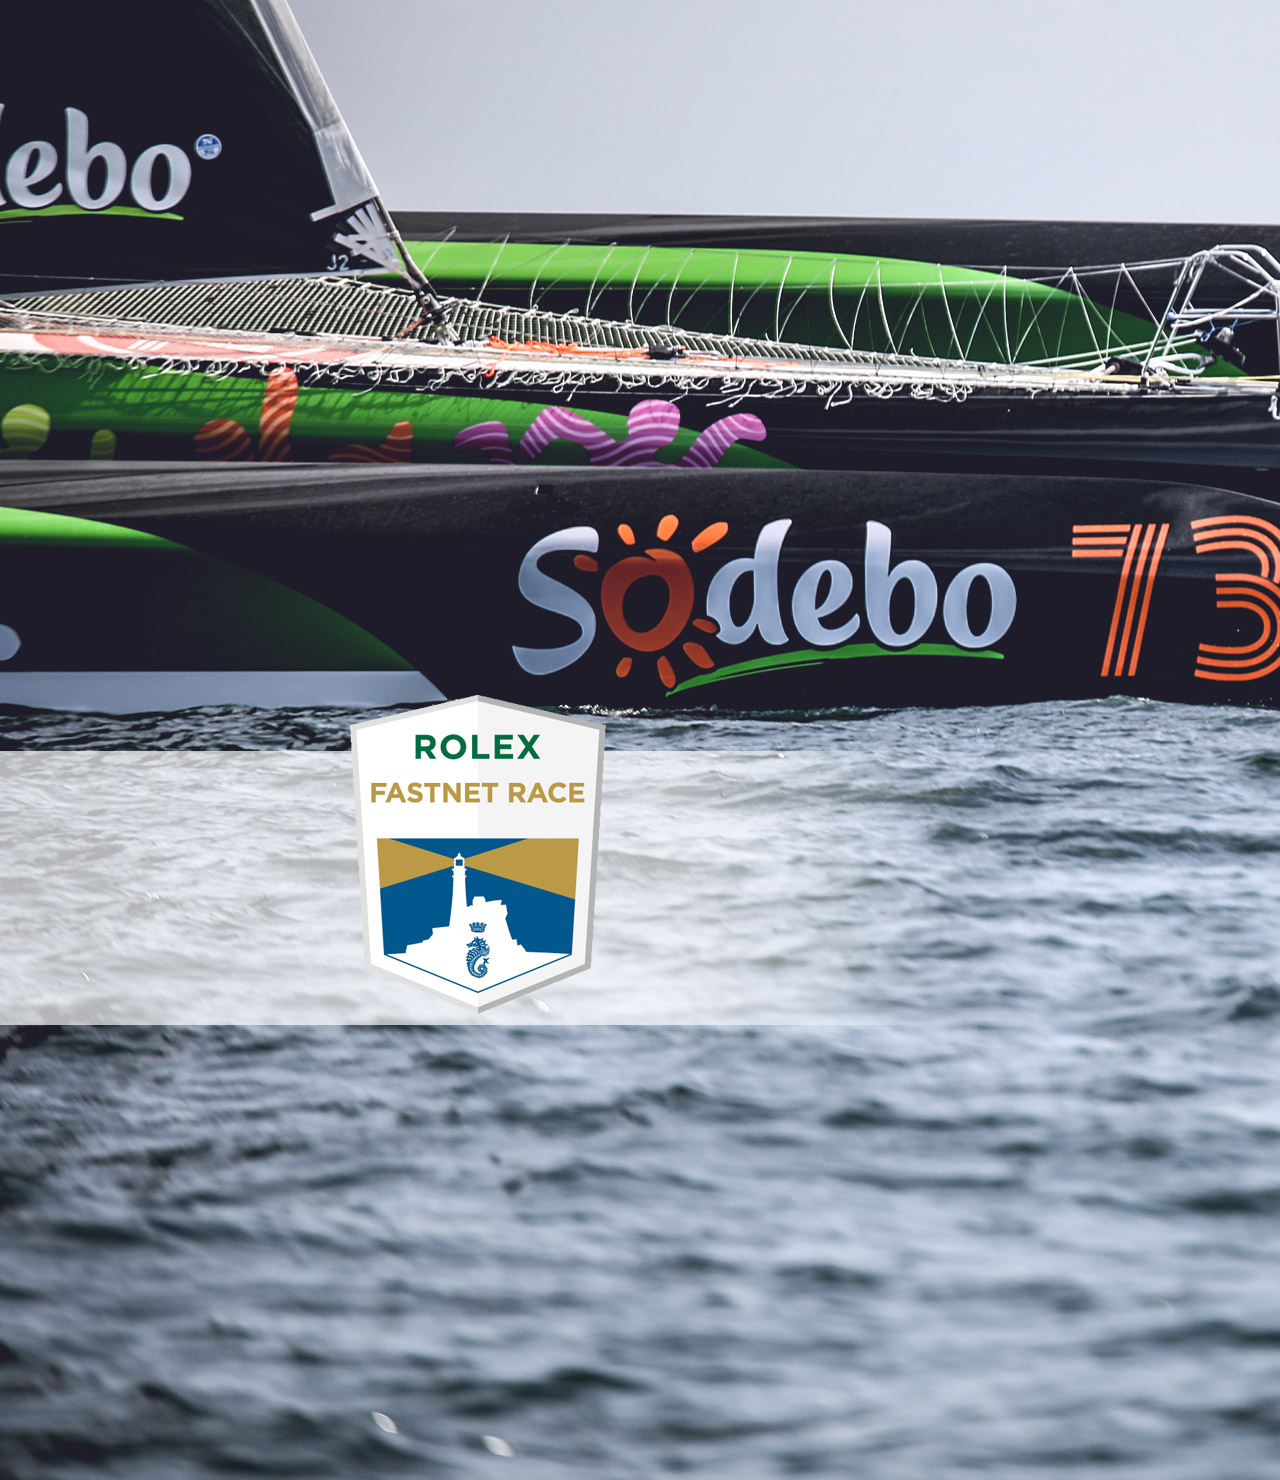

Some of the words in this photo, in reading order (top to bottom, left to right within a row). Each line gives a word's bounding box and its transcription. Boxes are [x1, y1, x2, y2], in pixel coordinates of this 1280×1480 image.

[0, 103, 192, 212] ebo
[326, 254, 350, 271] J2
[512, 516, 1017, 678] Sodebo
